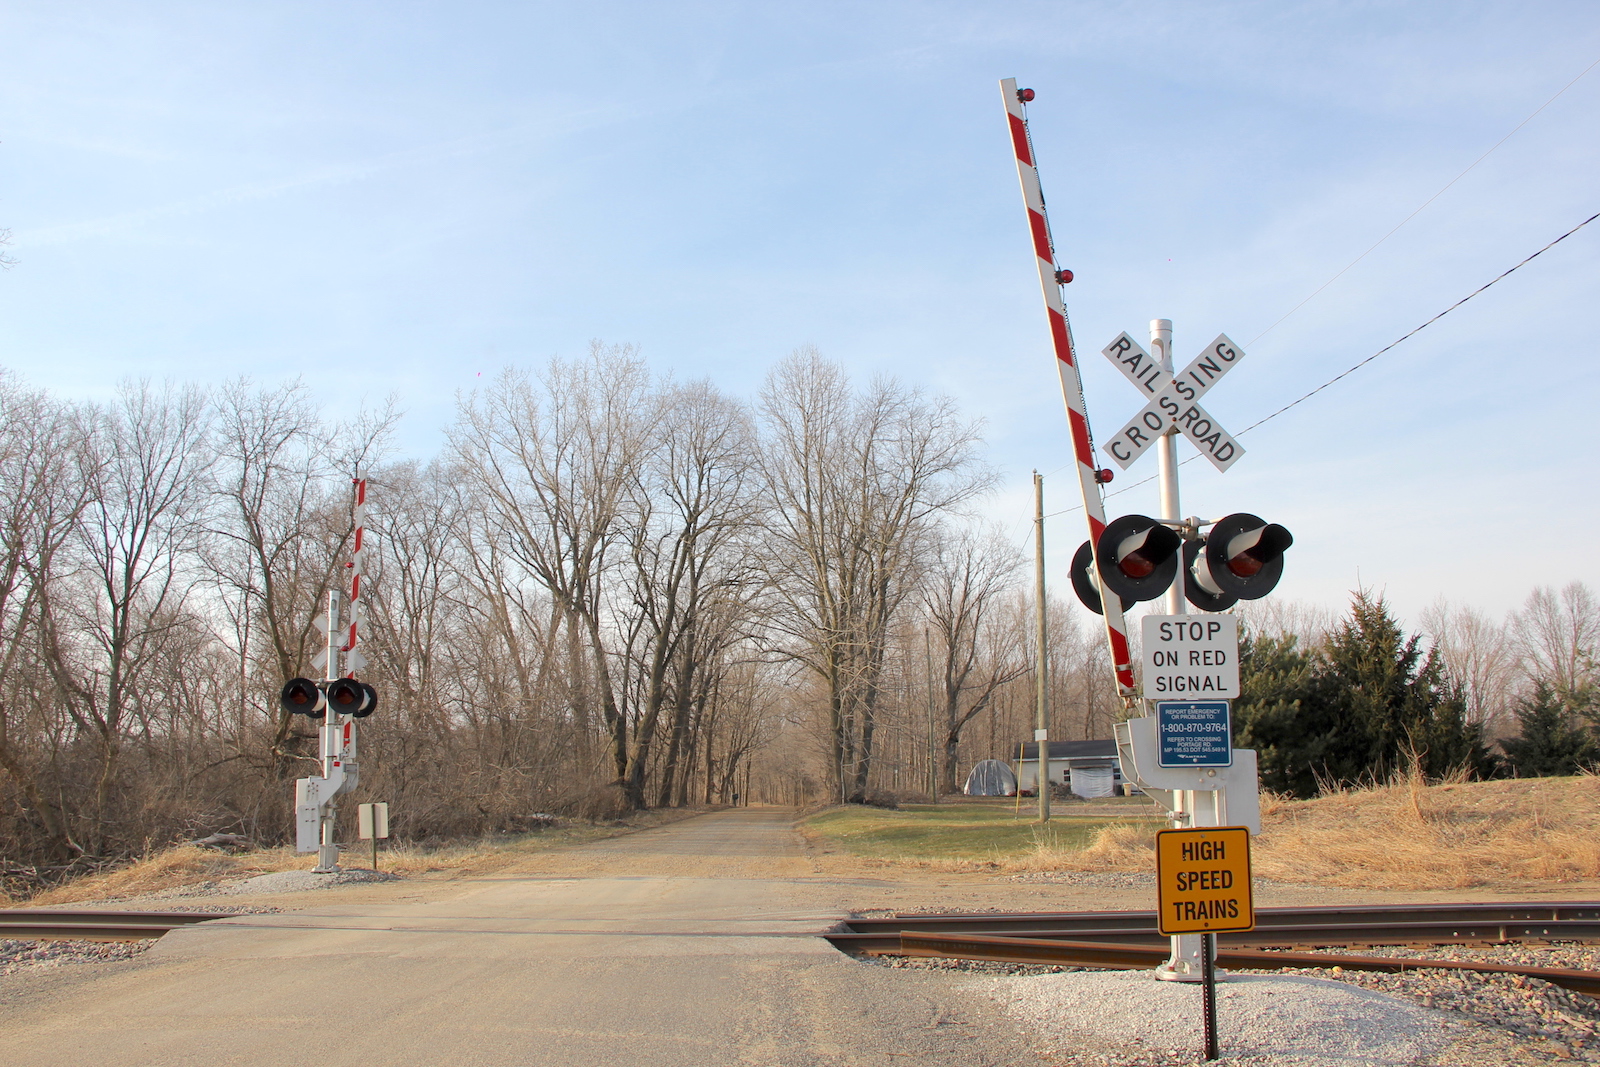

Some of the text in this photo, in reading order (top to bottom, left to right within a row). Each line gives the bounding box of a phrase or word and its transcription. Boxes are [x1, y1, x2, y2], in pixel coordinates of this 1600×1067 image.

[1109, 336, 1235, 462] RAIL ROAD
[1111, 342, 1236, 461] CROSSING
[1159, 621, 1221, 642] STOP
[1153, 650, 1226, 667] ON RED
[1156, 675, 1228, 692] SIGNAL
[1161, 723, 1227, 732] 1-800-870-9764
[1182, 841, 1225, 861] HIGH
[1176, 870, 1233, 892] SPEED
[1173, 899, 1239, 921] TRAINS
